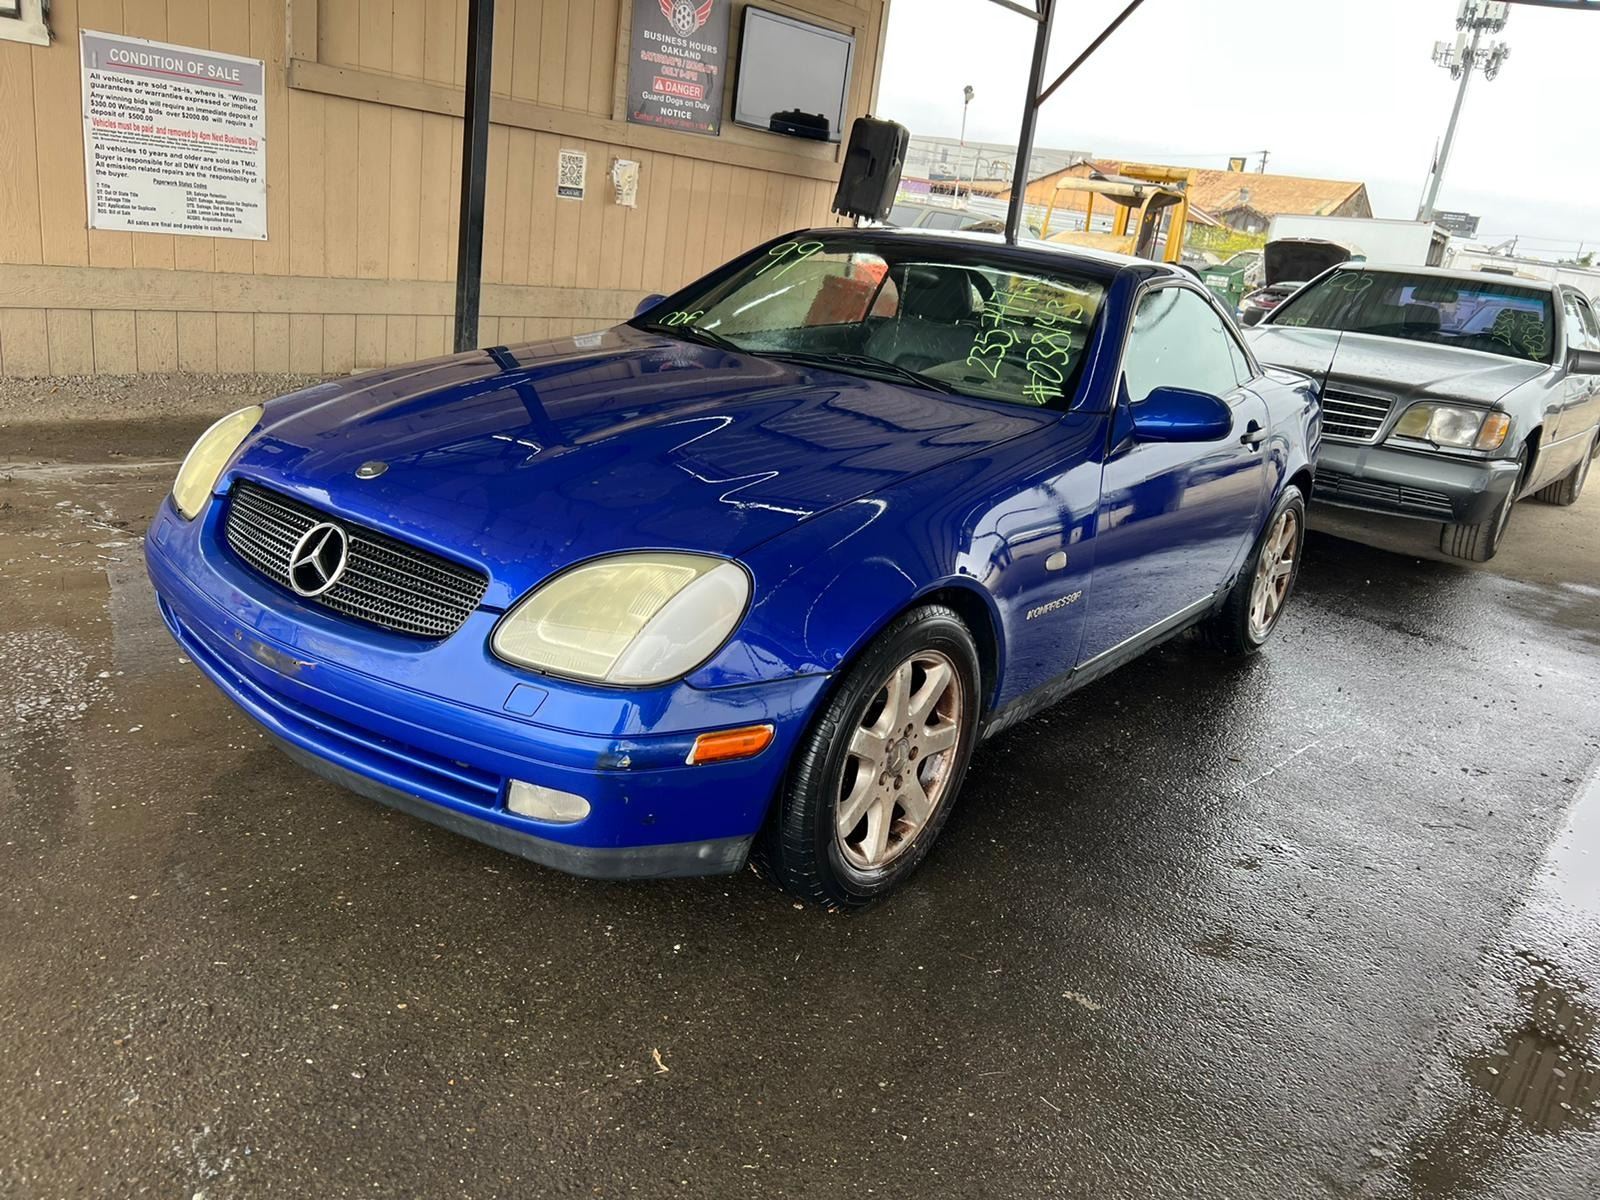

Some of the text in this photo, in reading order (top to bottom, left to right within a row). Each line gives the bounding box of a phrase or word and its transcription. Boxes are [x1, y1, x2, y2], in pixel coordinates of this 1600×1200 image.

[643, 30, 718, 54] BUSINESS HOURS
[661, 44, 701, 60] OAKLAND
[110, 48, 239, 80] CONDITION OF SALE
[103, 76, 134, 85] vehicles
[665, 81, 701, 97] DANGER
[90, 82, 132, 93] guarantees
[145, 90, 182, 100] warranties
[185, 96, 221, 106] expressed
[90, 91, 105, 100] Any
[105, 94, 132, 104] winning
[196, 107, 227, 116] immediate
[642, 91, 665, 103] Guard
[666, 94, 684, 106] Dogs
[695, 99, 710, 112] Duty
[90, 100, 116, 109] $300.00
[118, 104, 145, 114] Winning
[182, 112, 209, 121] $2000.00
[91, 108, 116, 116] deposit
[128, 113, 153, 121] $500.00
[660, 107, 692, 120] NOTICE
[92, 118, 116, 128] Vehicles
[133, 123, 140, 131] be
[168, 129, 190, 138] removed
[192, 131, 198, 140] by
[200, 132, 210, 141] 4pm
[212, 133, 223, 142] Next
[225, 135, 247, 145] Business
[249, 138, 258, 147] Day
[210, 175, 249, 183] responsibility
[756, 242, 824, 280] 99
[1026, 590, 1082, 620] KOMPRESSOR
